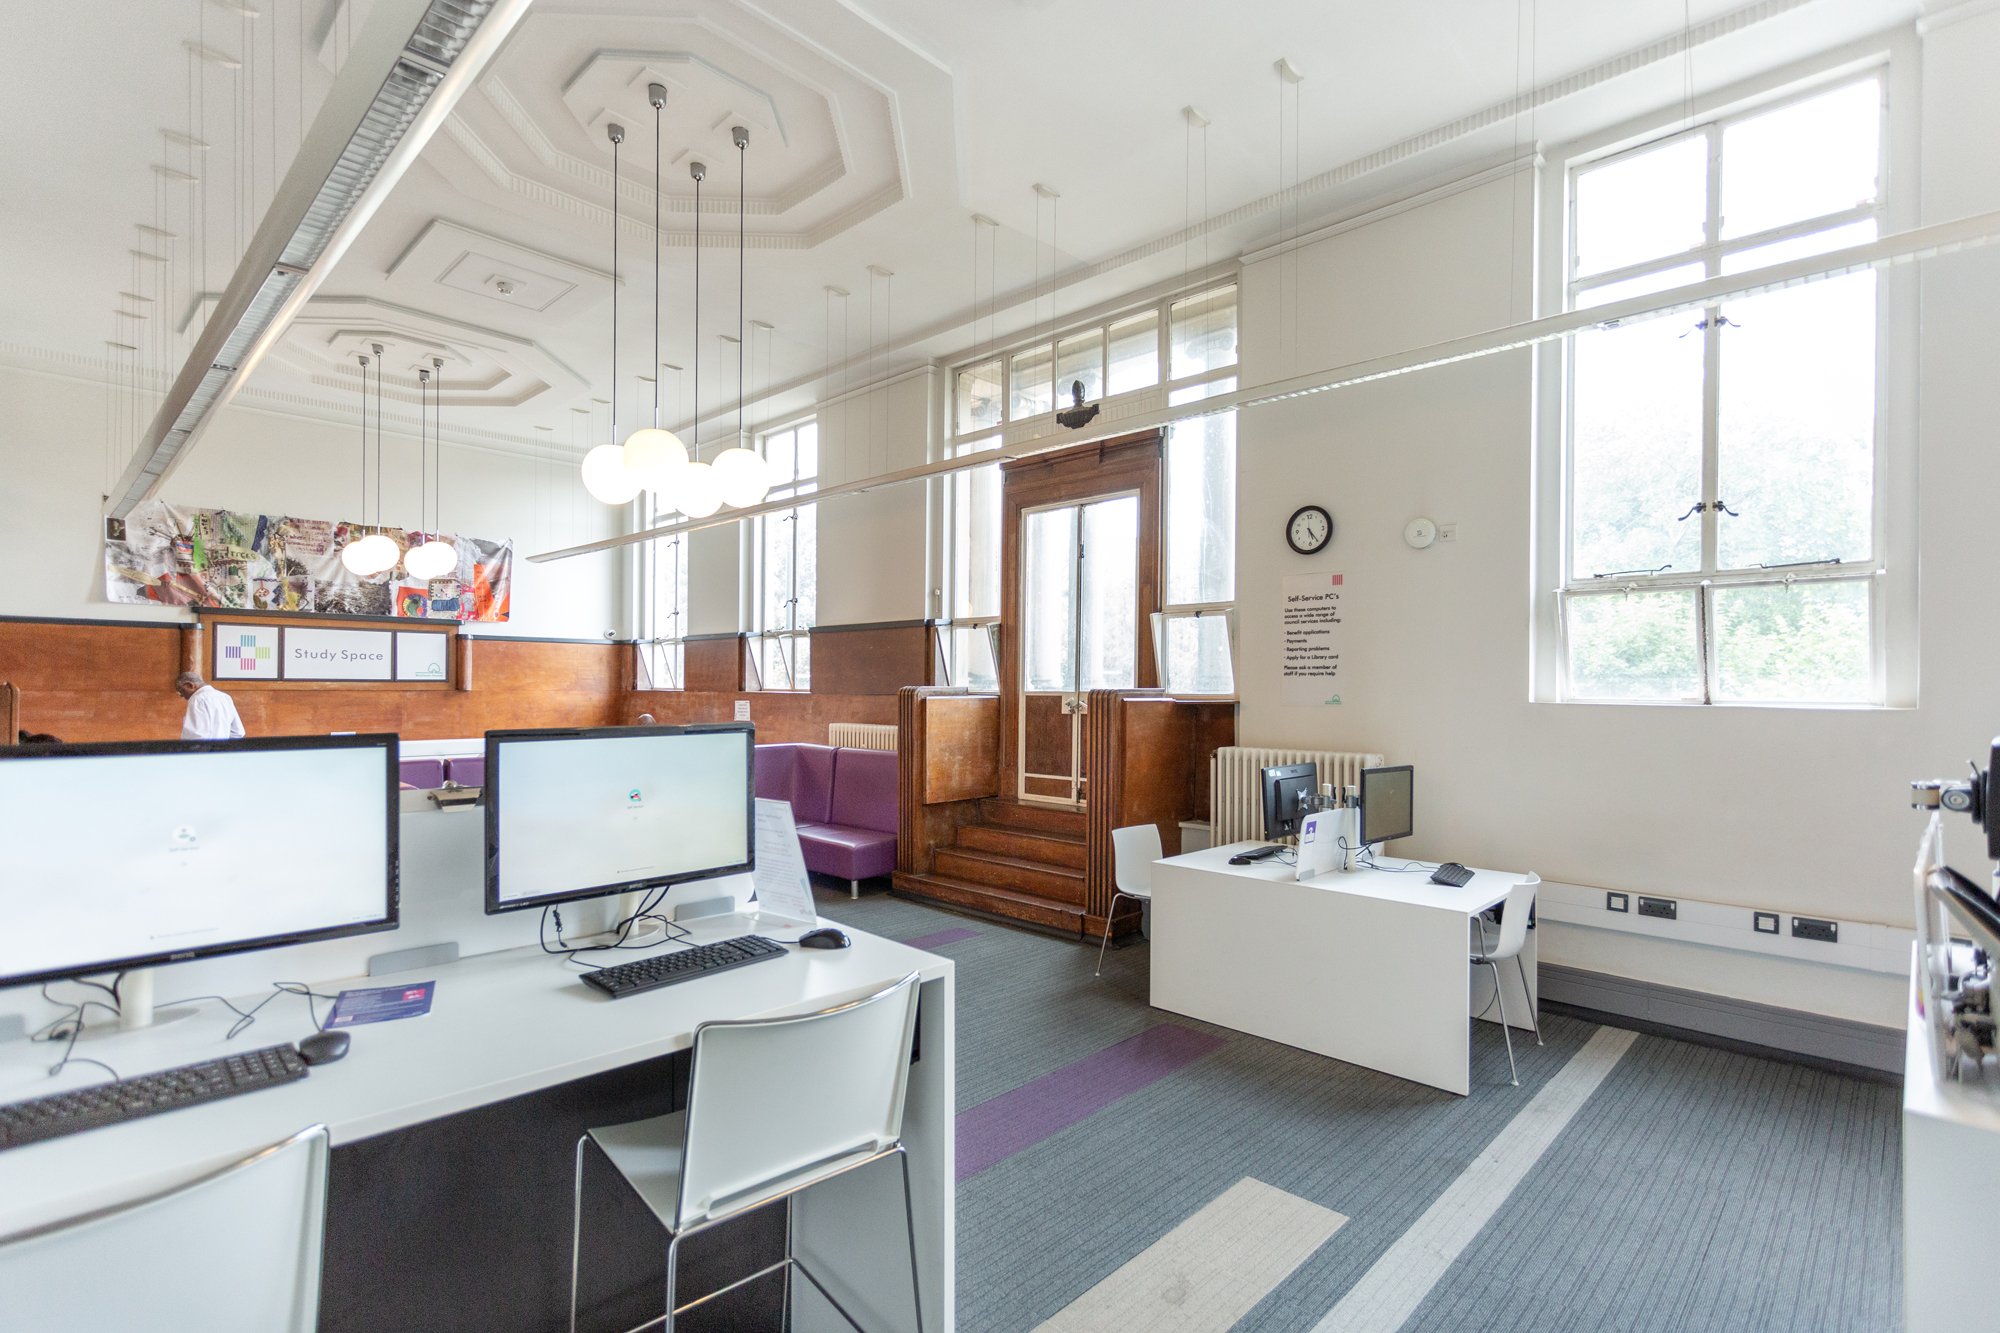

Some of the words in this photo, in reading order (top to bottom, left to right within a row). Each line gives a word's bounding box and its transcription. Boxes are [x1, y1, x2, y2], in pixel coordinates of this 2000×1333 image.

[1288, 594, 1323, 602] Self-Service
[294, 648, 337, 661] Study
[341, 649, 384, 662] Space
